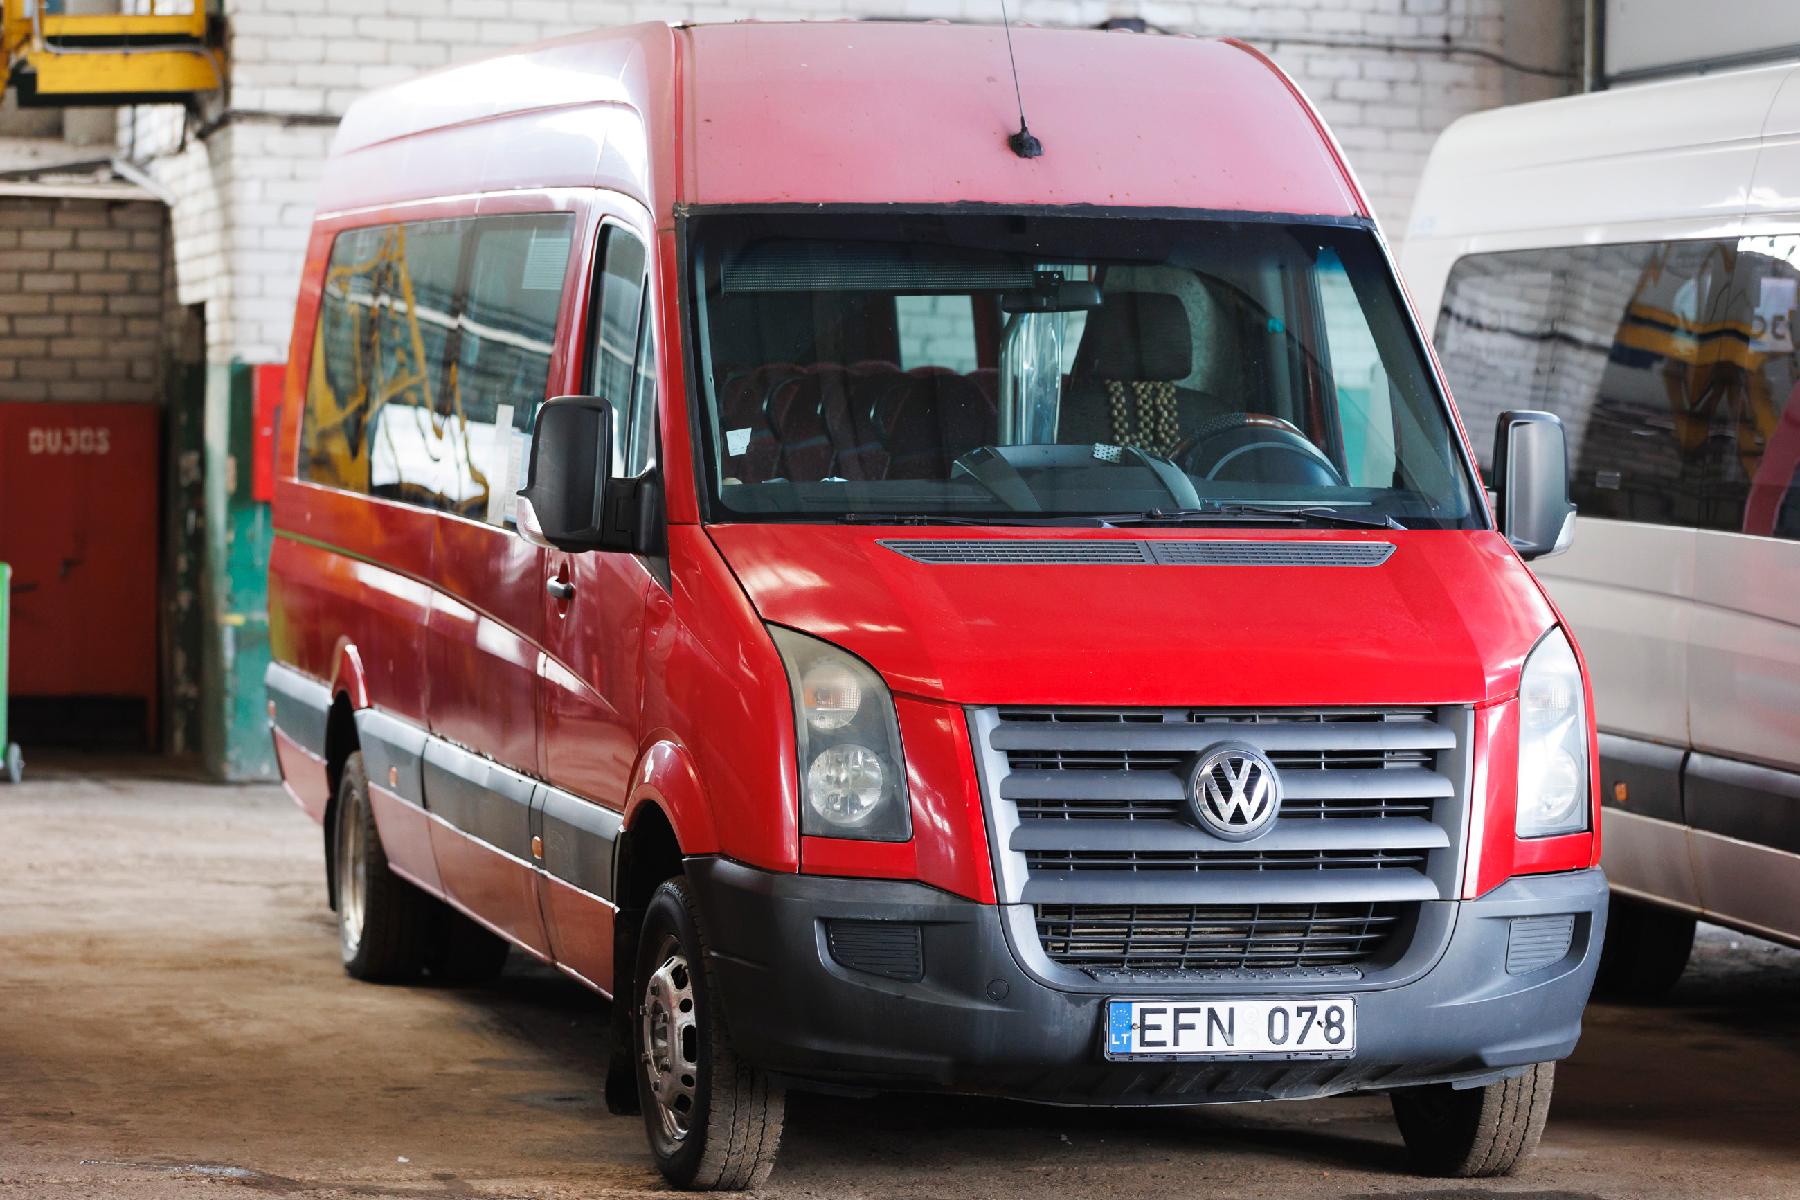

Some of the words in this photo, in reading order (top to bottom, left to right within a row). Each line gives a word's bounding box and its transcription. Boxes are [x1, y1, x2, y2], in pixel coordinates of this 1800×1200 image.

[28, 426, 111, 455] DUJOS
[1197, 752, 1274, 831] VW
[1111, 1033, 1130, 1045] LT
[1139, 1006, 1235, 1047] EFN
[1267, 1005, 1346, 1046] 078
